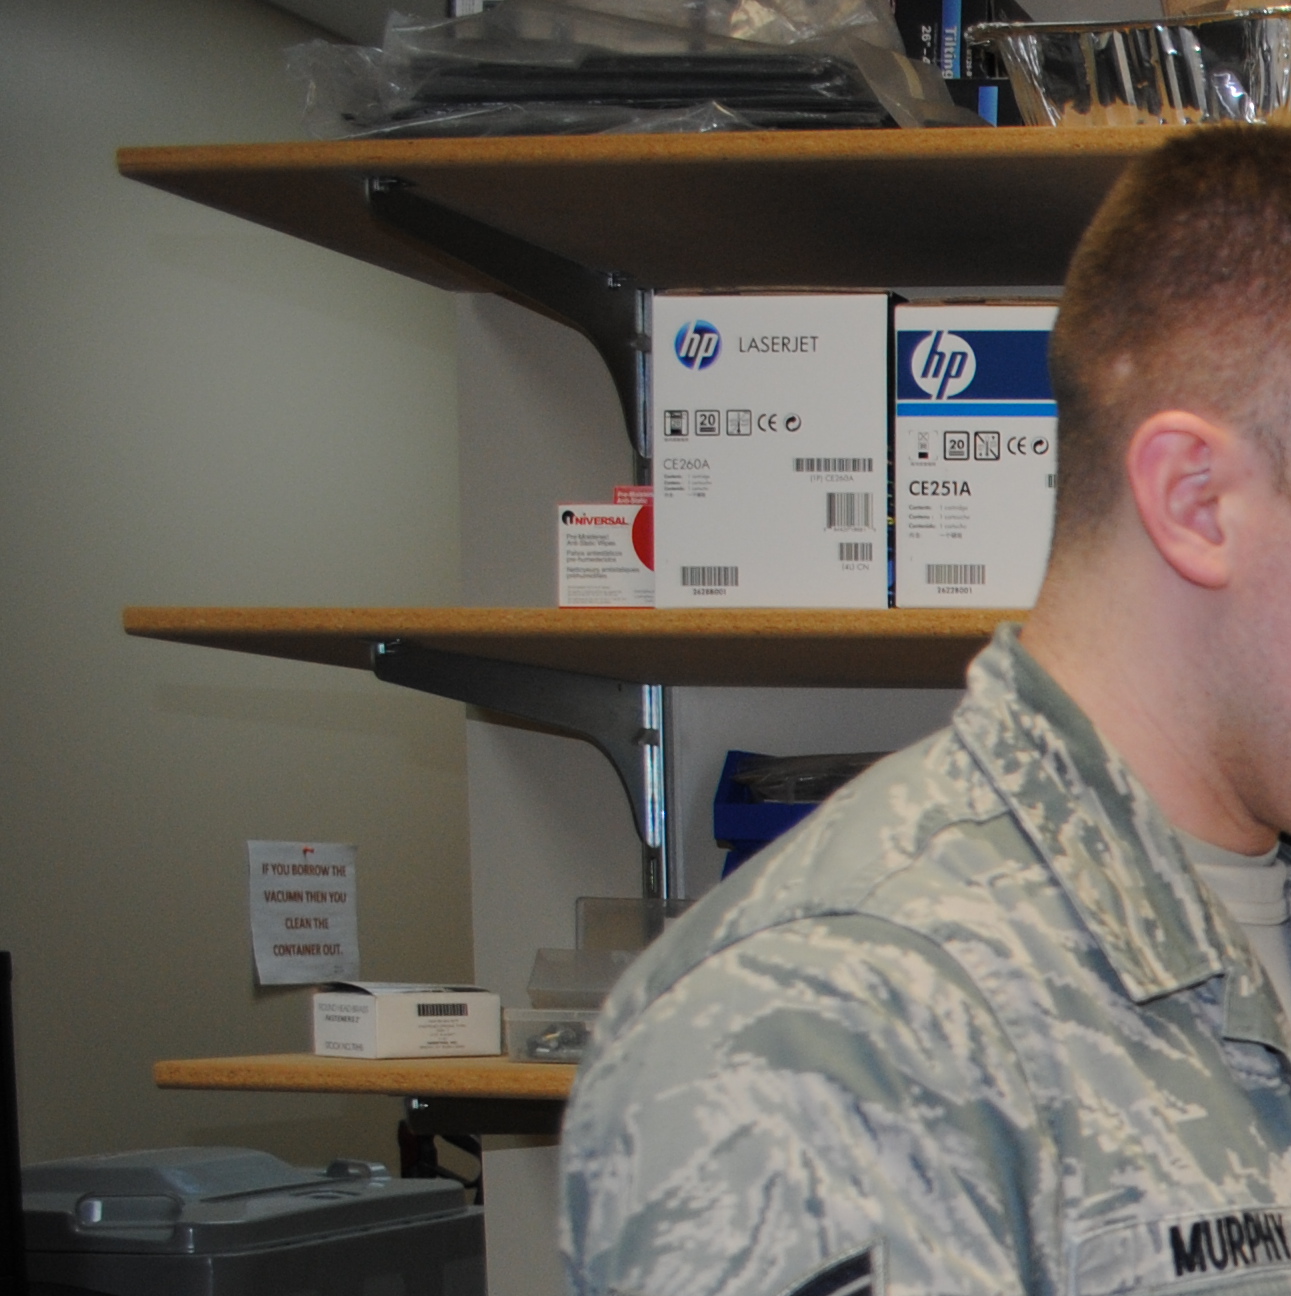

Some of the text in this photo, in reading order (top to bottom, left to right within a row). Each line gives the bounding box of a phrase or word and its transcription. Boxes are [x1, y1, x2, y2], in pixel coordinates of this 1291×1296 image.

[942, 26, 957, 79] Tilting
[678, 320, 719, 370] hp
[739, 335, 819, 353] LASERJET
[919, 331, 969, 399] hp
[700, 414, 715, 426] 20
[950, 440, 964, 450] 20
[663, 459, 710, 470] CE260A
[909, 480, 971, 496] CE251A
[263, 863, 346, 877] IF YOU BORROW THE
[305, 891, 327, 902] THEN
[329, 891, 347, 903] YOU
[285, 917, 329, 929] CLEAN THE
[273, 944, 320, 956] CONTAINER
[1169, 1212, 1291, 1277] MURPHY
